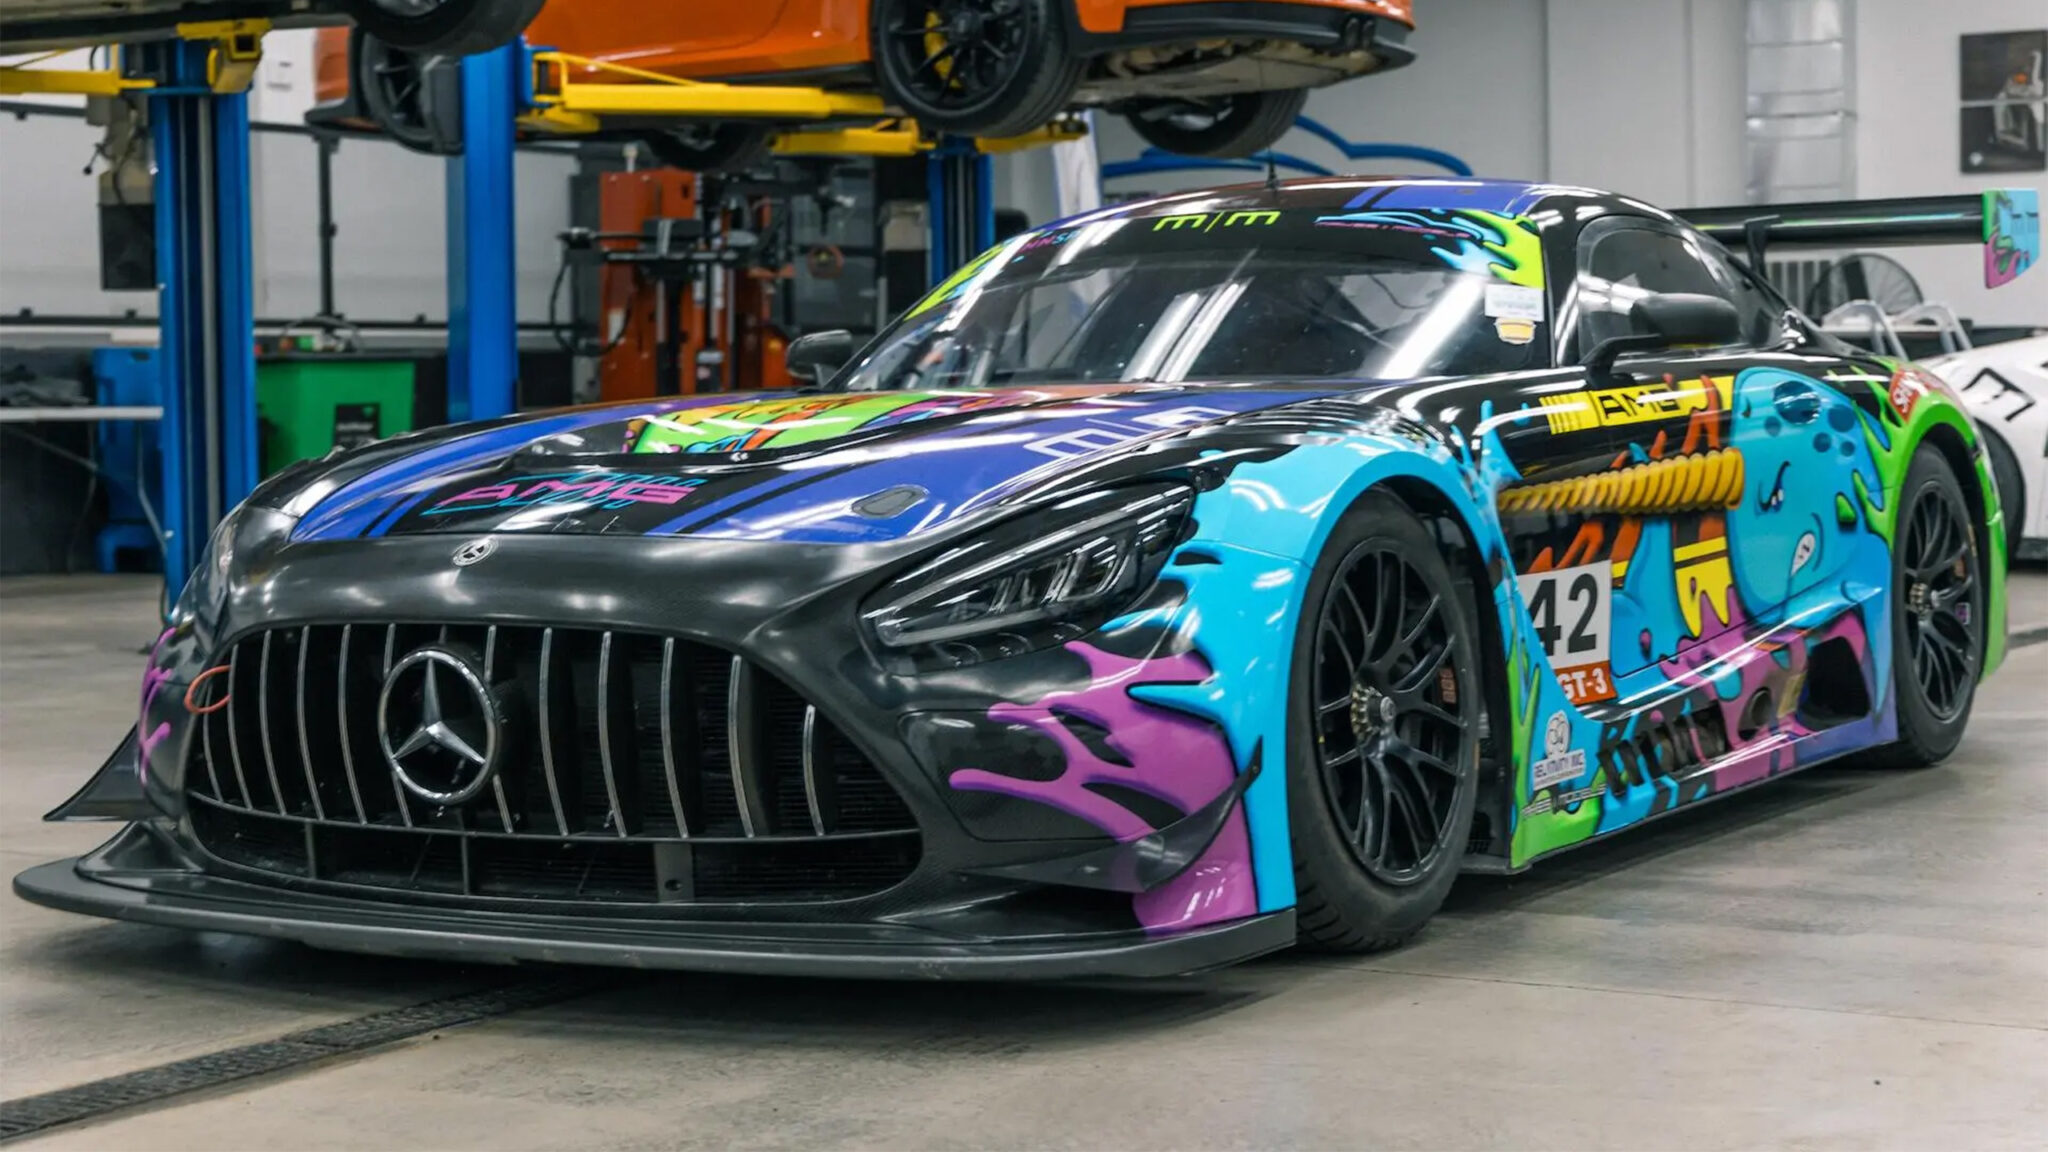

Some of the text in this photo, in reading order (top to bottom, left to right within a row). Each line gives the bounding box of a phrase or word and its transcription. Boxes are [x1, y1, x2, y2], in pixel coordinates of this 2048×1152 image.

[1597, 386, 1682, 420] AMG
[434, 479, 697, 505] AMG
[1528, 572, 1598, 657] 42
[1557, 667, 1608, 700] GT-3
